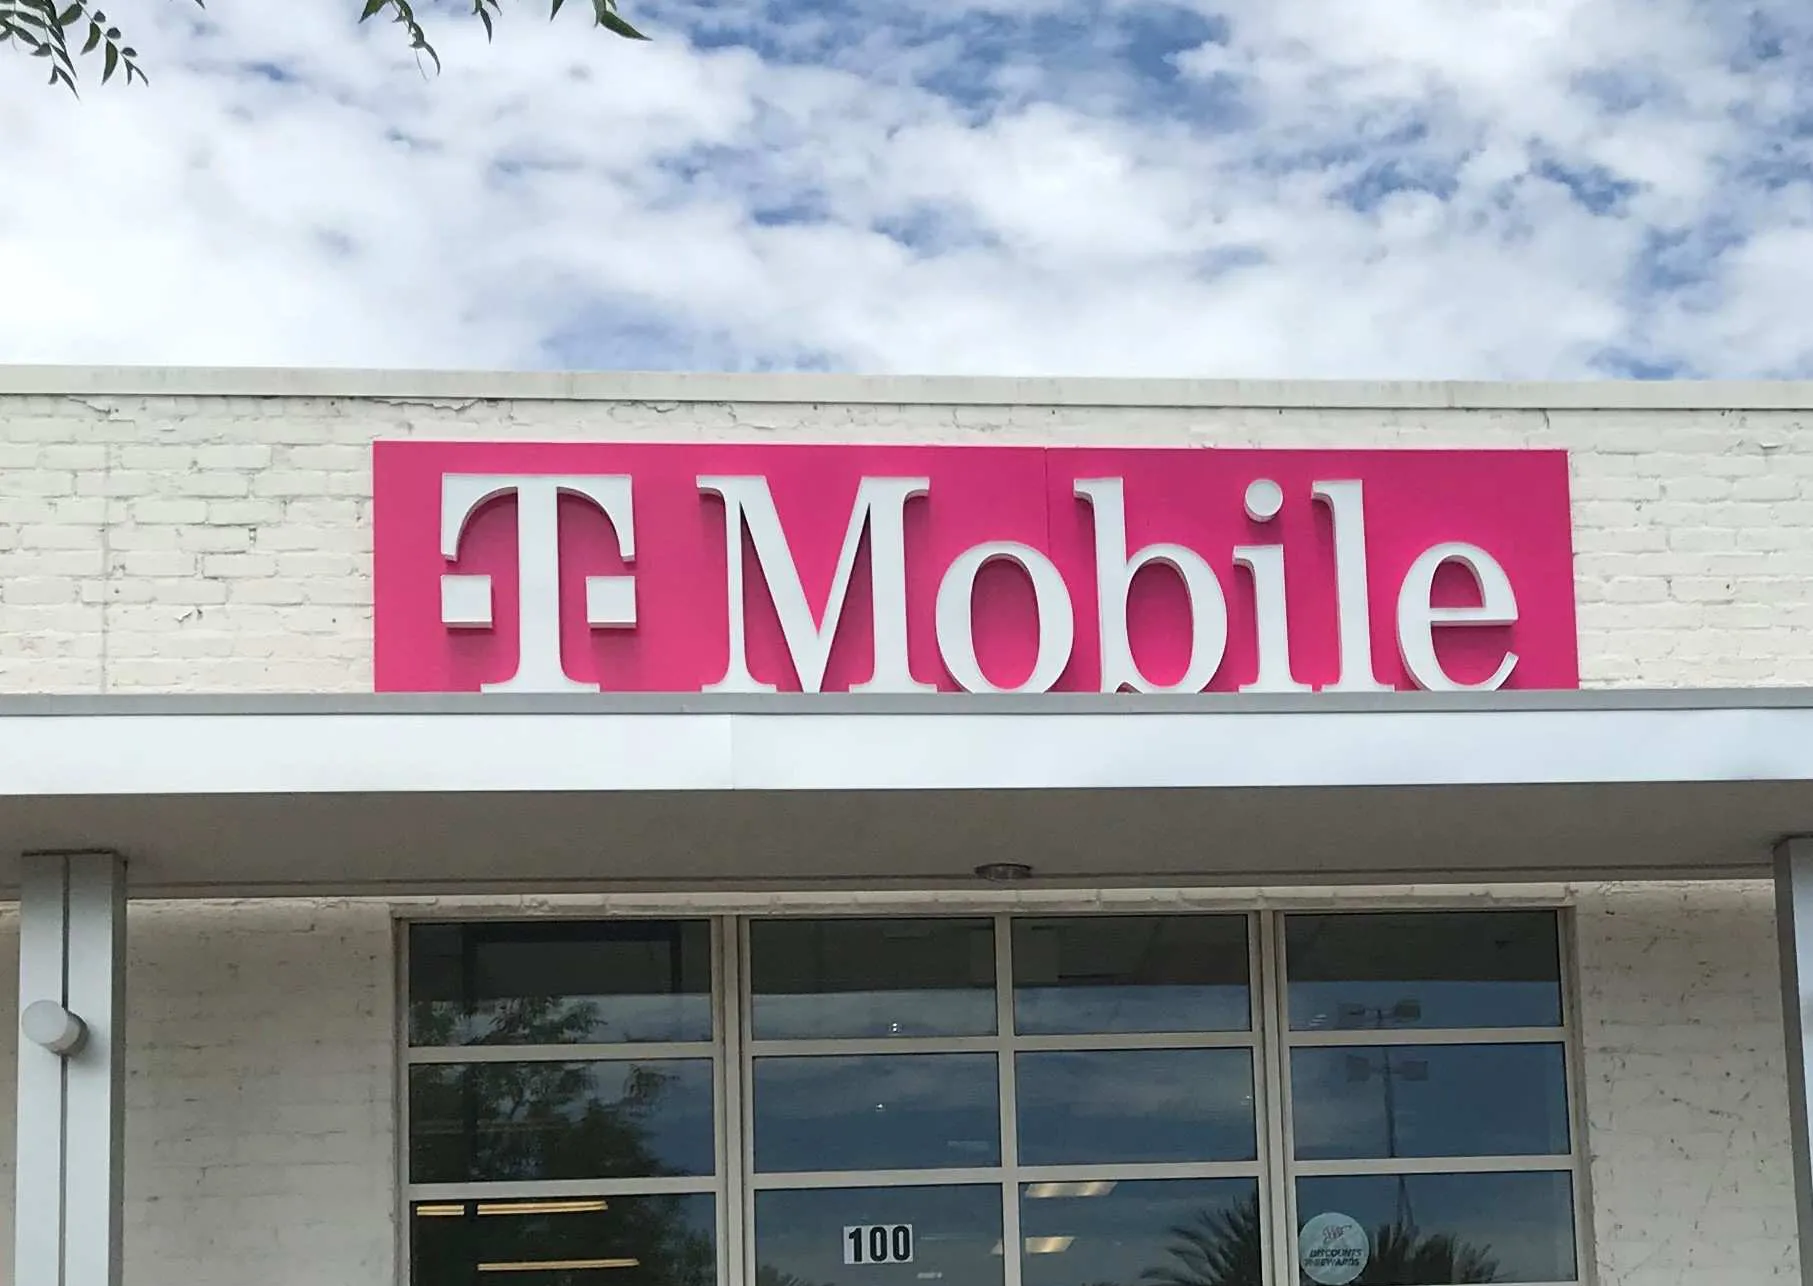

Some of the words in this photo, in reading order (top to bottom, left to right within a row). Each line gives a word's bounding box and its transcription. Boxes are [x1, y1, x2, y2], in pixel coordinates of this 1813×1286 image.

[441, 472, 637, 692] T
[696, 474, 1518, 692] Mobile
[848, 1225, 910, 1262] 100
